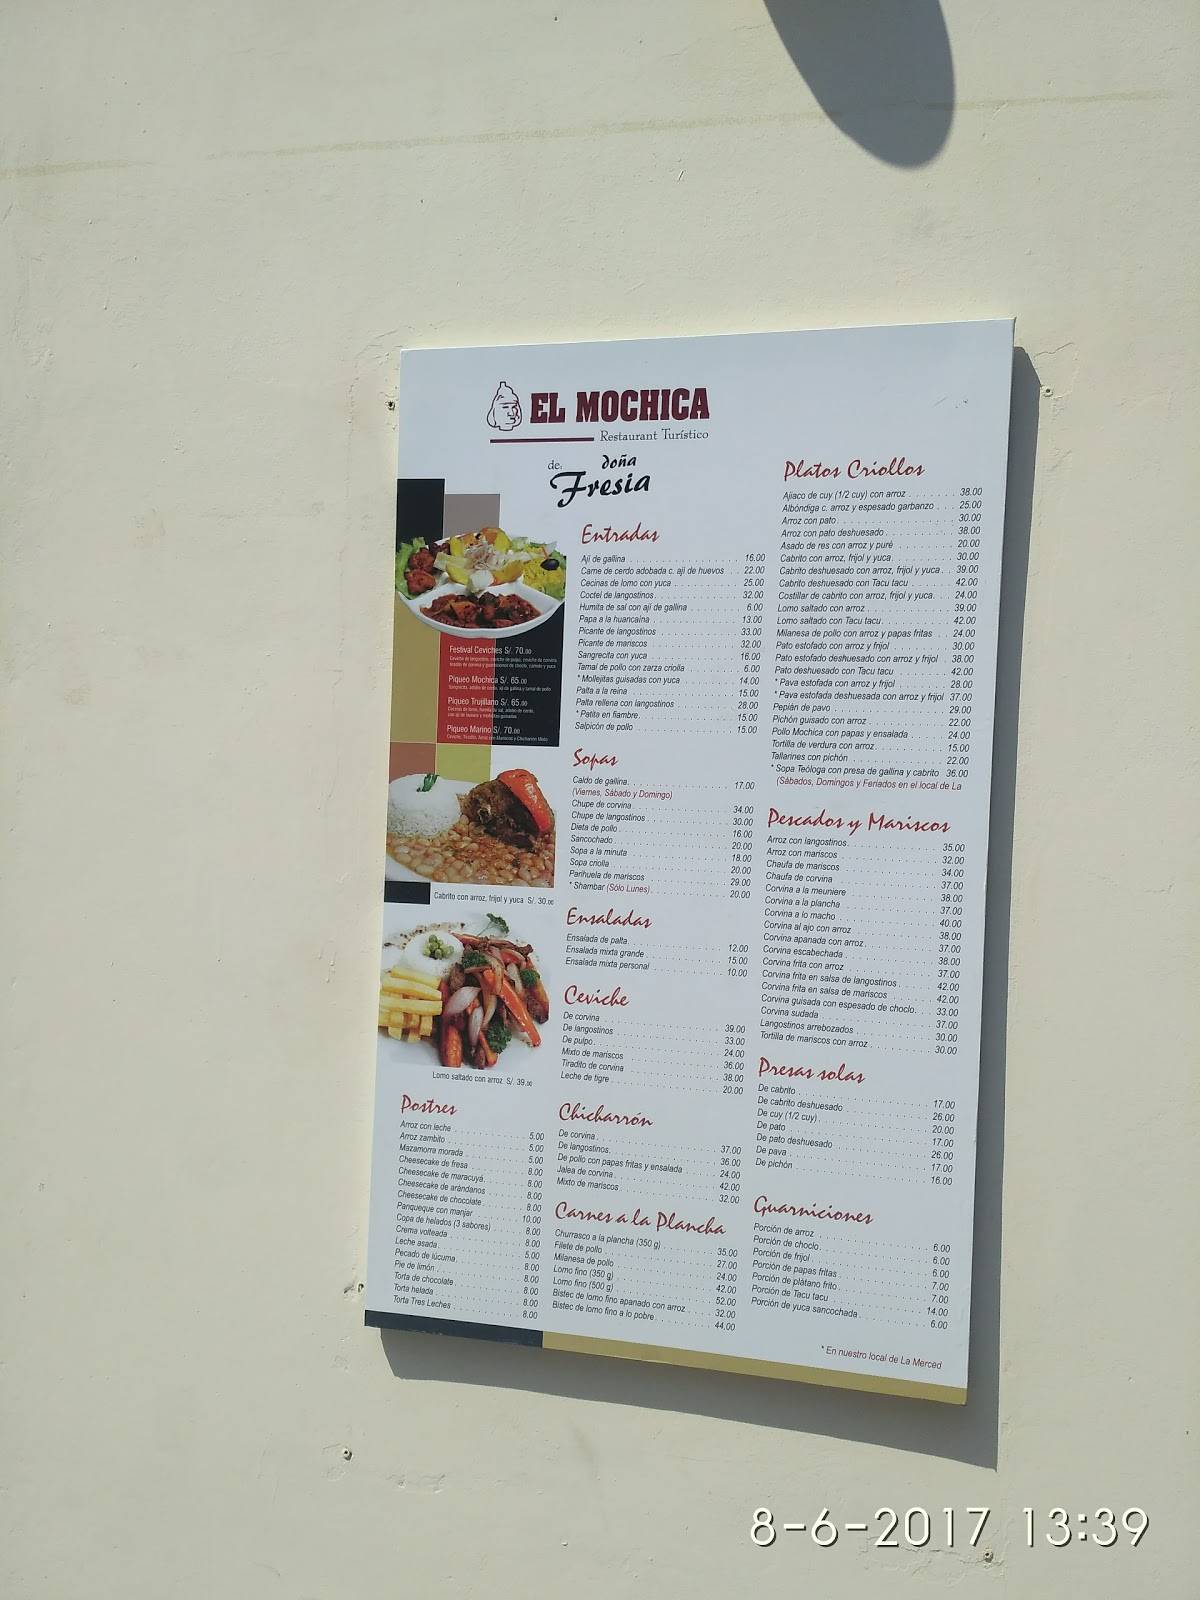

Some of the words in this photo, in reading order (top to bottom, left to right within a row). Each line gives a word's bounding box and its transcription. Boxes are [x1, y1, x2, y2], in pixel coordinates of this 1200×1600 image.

[530, 392, 565, 423] EL
[576, 388, 710, 422] MOCHICA
[600, 430, 658, 441] Restaurant
[661, 428, 708, 439] Turístico
[602, 454, 636, 469] doña
[784, 460, 841, 482] Platos
[848, 457, 925, 479] Criollos
[550, 471, 650, 508] Fresia
[582, 522, 660, 544] Entradas
[780, 528, 802, 537] Arroz
[818, 528, 836, 539] pato
[837, 526, 885, 536] deshuesado
[957, 525, 981, 534] 38.00
[580, 554, 591, 565] Ají
[591, 554, 602, 562] de
[601, 554, 626, 564] gallina
[745, 553, 766, 562] 16.00
[579, 578, 609, 587] Cecinas
[609, 578, 620, 587] de
[620, 578, 638, 587] lomo
[653, 580, 671, 588] yuca
[742, 578, 765, 586] 25.00
[778, 578, 806, 587] Cabrito
[807, 578, 854, 587] deshuesado
[872, 577, 890, 586] Tacu
[890, 578, 911, 586] tacu
[955, 577, 978, 586] 42.00
[776, 603, 799, 612] Lomo
[800, 603, 828, 612] saltado
[953, 603, 977, 612] 39.00
[449, 646, 472, 654] Festival
[474, 646, 502, 654] Ceviches
[577, 650, 615, 660] Sangrecita
[629, 652, 648, 661] yuca
[740, 652, 761, 660] 16.00
[448, 675, 469, 683] Piqueo
[472, 675, 498, 684] Mochica
[575, 697, 594, 706] Palta
[594, 697, 619, 706] rellena
[633, 698, 675, 709] langostinos
[737, 700, 759, 709] 28.00
[573, 748, 619, 771] Sopas
[771, 750, 806, 760] Tallarines
[822, 752, 849, 763] pichón
[946, 756, 970, 765] 22.00
[570, 798, 595, 809] Chupe
[595, 799, 605, 808] de
[606, 800, 632, 809] corvina
[732, 804, 754, 814] 34.00
[768, 808, 844, 828] Pescados
[847, 820, 862, 836] y
[868, 812, 951, 833] Mariscos
[569, 857, 588, 868] Sopa
[588, 858, 610, 867] criolla
[730, 865, 752, 874] 20.00
[765, 858, 794, 868] Chaufa
[794, 860, 805, 869] de
[805, 861, 840, 870] mariscos
[941, 867, 964, 877] 34.00
[567, 907, 652, 928] Ensaladas
[565, 944, 598, 954] Ensalada
[598, 947, 619, 956] mixta
[618, 947, 645, 959] grande
[727, 955, 748, 965] 15.00
[762, 944, 792, 955] Corvina
[792, 946, 844, 958] escabechada
[937, 956, 961, 966] 38.00
[565, 985, 630, 1006] Ceviche
[759, 1018, 806, 1032] Langostinos
[806, 1021, 854, 1033] arrebozados
[935, 1032, 958, 1042] 30.00
[432, 1071, 449, 1080] Lomo
[451, 1072, 472, 1082] saltado
[562, 1058, 587, 1068] Tiradito
[587, 1060, 598, 1069] de
[598, 1062, 624, 1071] corvina
[722, 1072, 744, 1082] 38.00
[759, 1057, 813, 1079] Presas
[817, 1063, 866, 1084] solas
[560, 1070, 582, 1080] Leche
[583, 1072, 593, 1081] de
[593, 1073, 610, 1084] tigre
[722, 1085, 744, 1095] 20.00
[401, 1094, 457, 1115] Postres
[559, 1103, 653, 1127] Chicharrón
[756, 1095, 769, 1105] De
[769, 1096, 796, 1107] cabrito
[796, 1098, 843, 1111] deshuesado
[932, 1112, 955, 1122] 26.00
[400, 1119, 418, 1129] Arroz
[432, 1122, 451, 1132] leche
[528, 1131, 545, 1140] 5.00
[398, 1142, 437, 1154] Mazamorra
[437, 1146, 464, 1156] morada
[527, 1155, 544, 1164] 5.00
[398, 1154, 440, 1166] Cheesecake
[440, 1158, 450, 1167] de
[450, 1159, 468, 1169] fresa
[527, 1167, 543, 1176] 8.00
[755, 1156, 767, 1166] De
[767, 1158, 793, 1171] pichón
[930, 1175, 953, 1185] 16.00
[556, 1176, 576, 1186] Mixto
[576, 1178, 586, 1187] de
[586, 1180, 619, 1190] mariscos
[718, 1193, 740, 1204] 32.00
[556, 1201, 614, 1224] Carnes
[616, 1212, 628, 1226] a
[631, 1208, 650, 1227] la
[656, 1211, 727, 1236] Plancha
[754, 1195, 873, 1224] Guarniciones
[553, 1252, 585, 1263] Milanesa
[586, 1255, 596, 1265] de
[596, 1256, 614, 1269] pollo
[716, 1271, 738, 1282] 24.00
[751, 1259, 781, 1271] Porción
[781, 1262, 793, 1272] de
[792, 1265, 817, 1277] papas
[818, 1266, 838, 1277] fritas
[931, 1281, 950, 1291] 7.00
[393, 1294, 409, 1304] Torta
[411, 1296, 426, 1306] Tres
[426, 1298, 451, 1309] Leches
[522, 1309, 538, 1319] 8.00
[825, 1345, 837, 1355] En
[838, 1348, 867, 1359] nuestro
[868, 1351, 887, 1362] local
[888, 1353, 899, 1363] de
[900, 1354, 911, 1364] La
[912, 1356, 942, 1368] Merced
